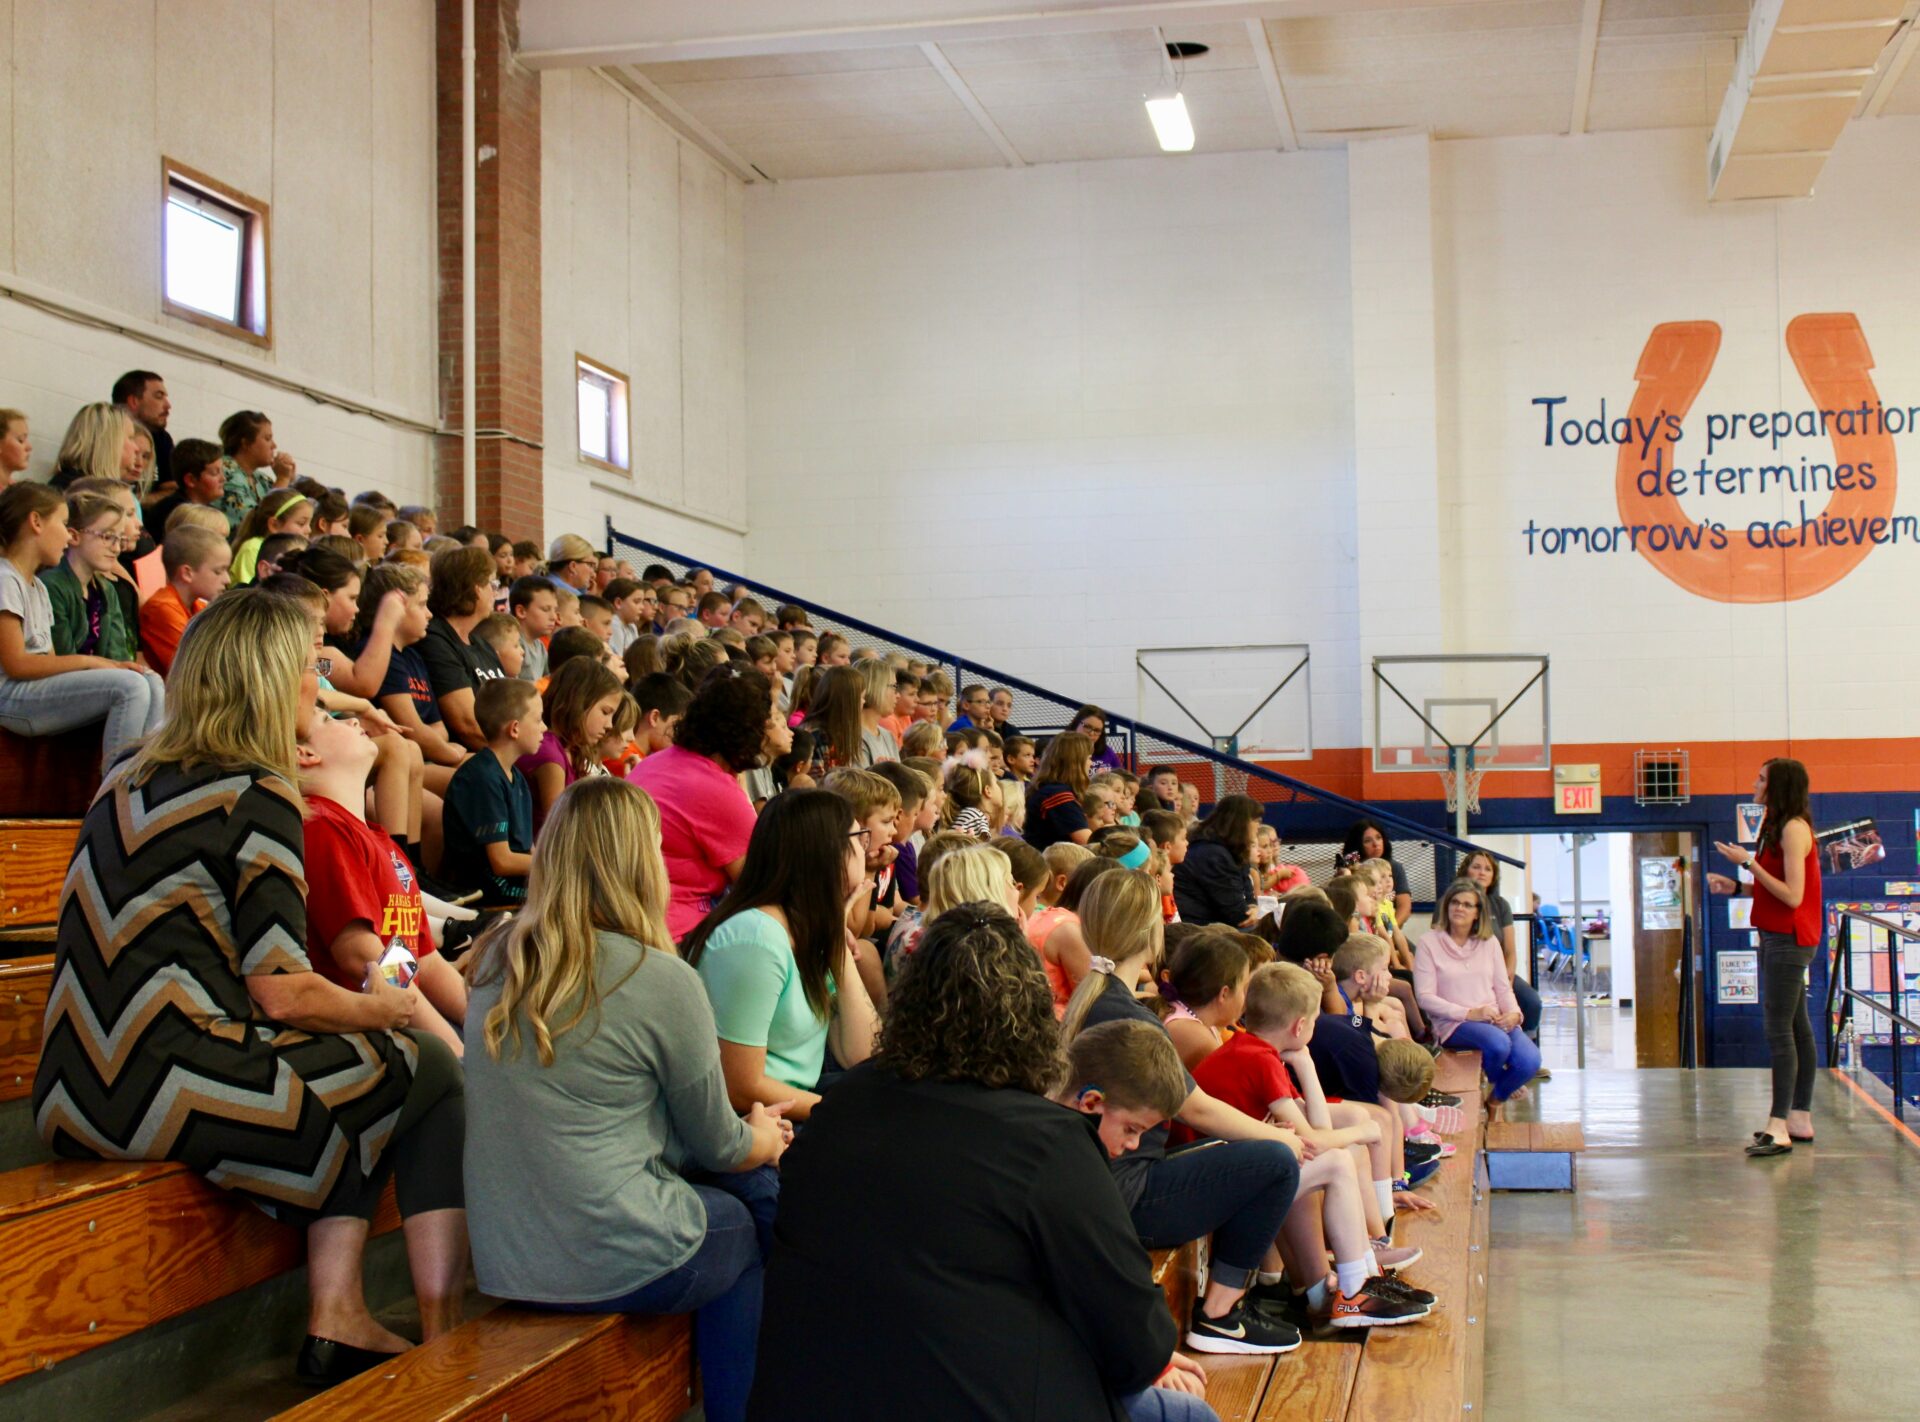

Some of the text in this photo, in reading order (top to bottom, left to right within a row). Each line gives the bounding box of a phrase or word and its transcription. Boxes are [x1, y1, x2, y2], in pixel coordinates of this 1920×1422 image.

[1532, 395, 1684, 460] Today's
[1637, 448, 1877, 498] determines
[1522, 518, 1729, 555] tomorrow's
[1563, 787, 1594, 809] EXIT
[1725, 960, 1741, 968] LIKE
[1721, 985, 1754, 996] TIMES
[1337, 1304, 1360, 1313] FILA
